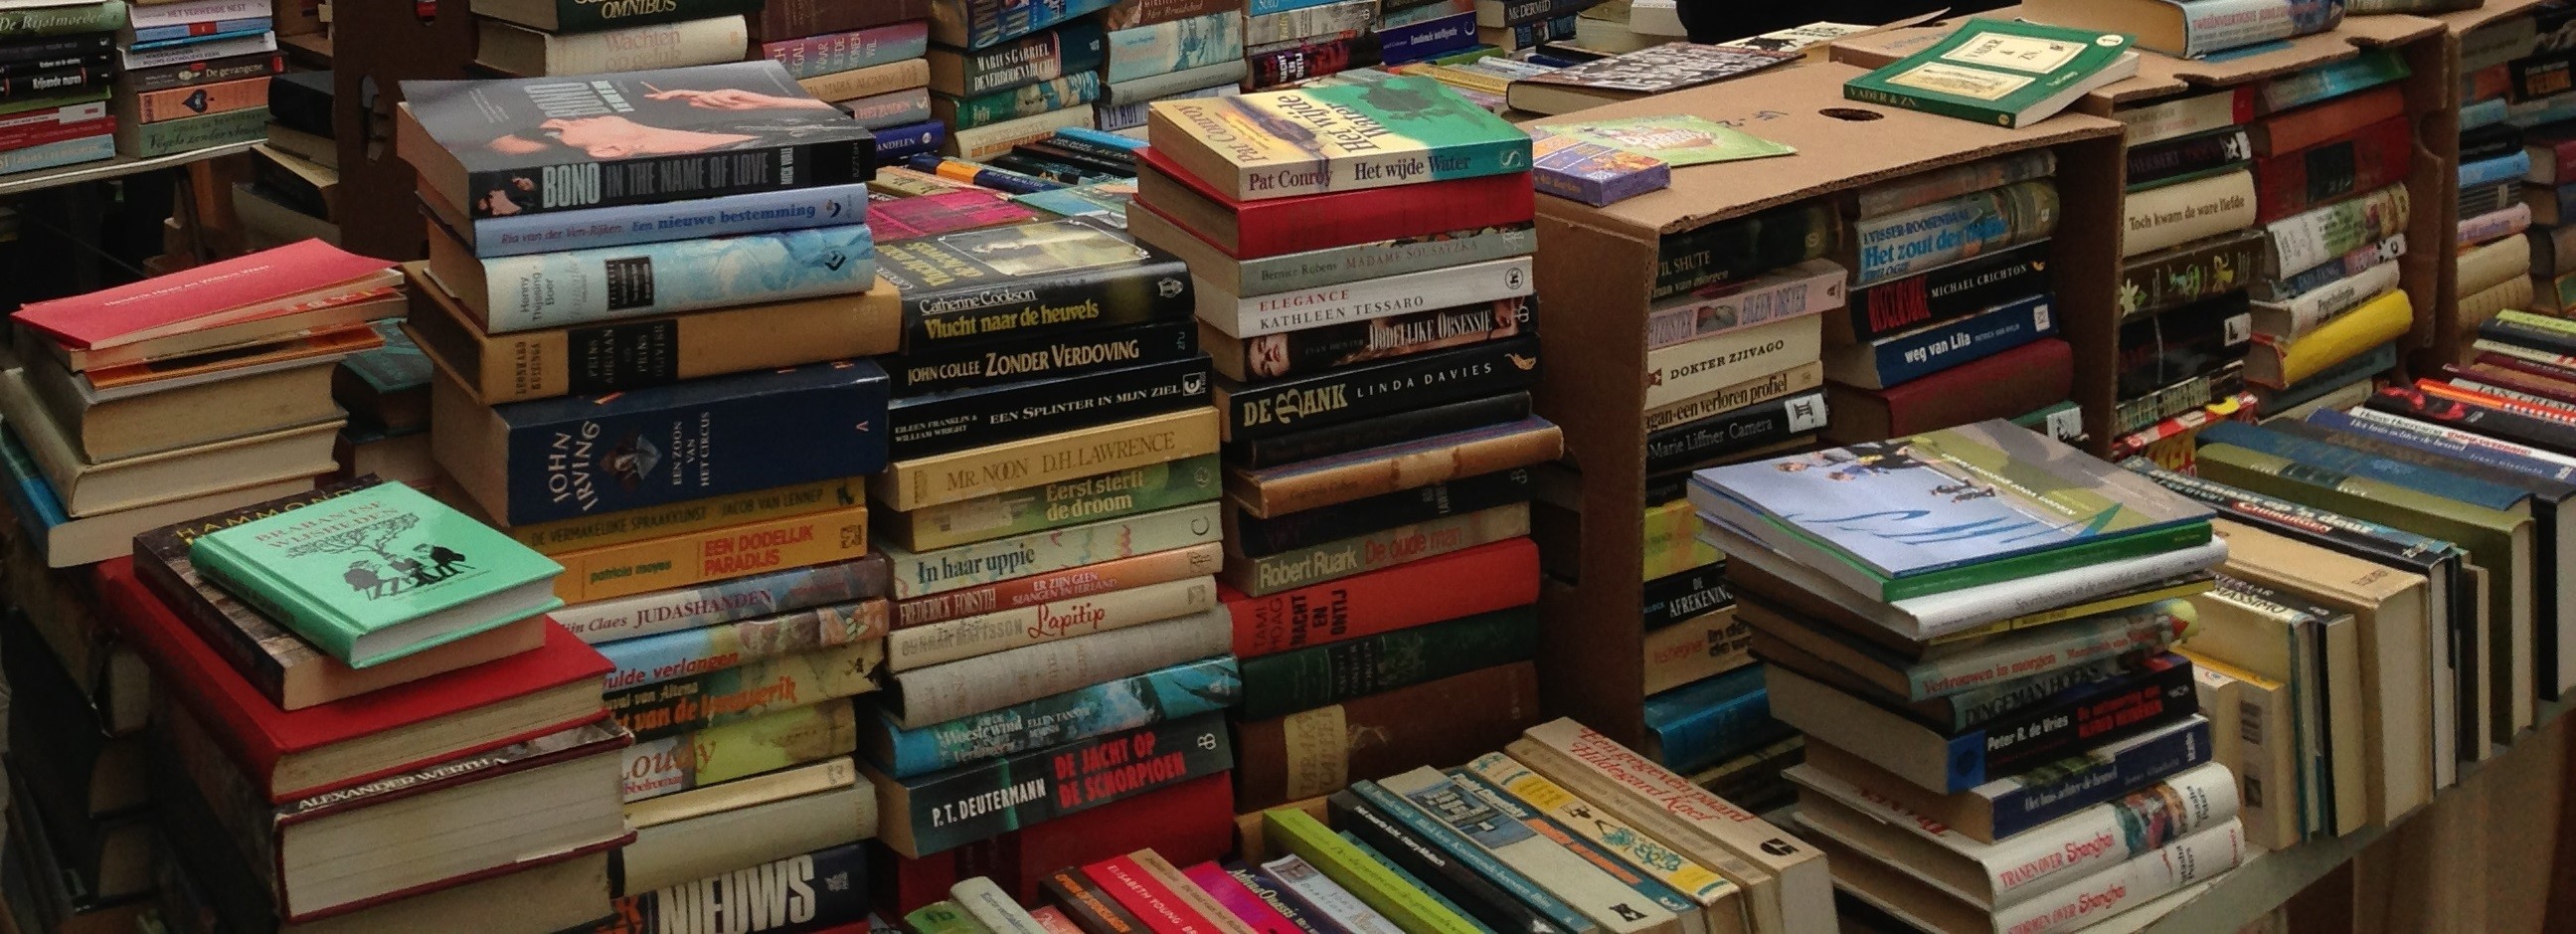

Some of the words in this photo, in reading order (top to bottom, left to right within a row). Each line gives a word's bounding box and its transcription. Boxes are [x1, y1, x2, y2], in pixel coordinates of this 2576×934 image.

[601, 0, 676, 20] OMNIBUS
[542, 162, 600, 209] BONO
[606, 169, 624, 196] IN
[628, 163, 655, 193] THE
[661, 157, 704, 192] NAME
[709, 155, 728, 187] OF
[734, 152, 769, 185] LOVE
[1250, 168, 1274, 191] Pat
[1279, 158, 1333, 189] Conroy
[1355, 162, 1385, 181] Het
[1386, 158, 1424, 181] wijde
[1428, 154, 1470, 173] Water
[658, 213, 715, 229] nieuwe
[720, 204, 815, 228] bestemming
[2130, 215, 2152, 231] Toch
[2153, 210, 2183, 226] kwam
[2185, 205, 2195, 219] de
[2197, 204, 2218, 217] ware
[2219, 196, 2245, 213] liefde
[1864, 246, 1894, 270] Het
[1897, 239, 1933, 263] zout
[920, 292, 979, 315] Catherine
[980, 287, 1037, 305] Cookson
[925, 317, 976, 340] Vlucht
[982, 311, 1018, 333] naar
[1020, 305, 1038, 326] de
[1041, 298, 1100, 323] heuvels
[1260, 288, 1350, 311] ELEGANCE
[1261, 307, 1346, 331] KATHLEEN
[1355, 296, 1424, 320] TESSARO
[908, 367, 938, 385] JOHN
[940, 360, 980, 380] COLLEE
[985, 352, 1048, 377] ZONDER
[1051, 340, 1139, 368] VERDOVING
[1670, 356, 1726, 380] DOKTER
[1729, 340, 1785, 364] ZJIVAGO
[1905, 347, 1927, 364] weg
[1929, 342, 1948, 356] van
[989, 411, 1018, 425] EEN
[1023, 397, 1095, 420] SPLINTER
[1099, 396, 1112, 407] IN
[1151, 385, 1181, 398] ZIEL
[1243, 400, 1272, 427] DE
[1356, 377, 1415, 398] LINDA
[1424, 362, 1493, 385] DAVIES
[1750, 374, 1788, 404] profiel
[1729, 418, 1774, 439] Camera
[548, 432, 572, 504] JOHN
[572, 420, 602, 511] IRVING
[687, 438, 696, 464] VAN
[1078, 431, 1175, 467] LAWRENCE
[1067, 493, 1132, 518] droom
[918, 561, 939, 584] In
[944, 556, 982, 580] haar
[985, 543, 1035, 577] uppie
[1259, 557, 1312, 589] Robert
[1313, 546, 1358, 576] Ruark
[1364, 539, 1385, 564] De
[589, 617, 627, 631] Claes
[633, 590, 772, 630] JUDASHANDEN
[1255, 605, 1269, 650] TAMI
[1270, 597, 1285, 650] HOAG
[1291, 594, 1306, 647] NACHT
[1053, 755, 1076, 781] DE
[1133, 731, 1156, 758] OP
[1987, 728, 2015, 751] Peter
[2029, 723, 2041, 738] de
[959, 778, 1046, 821] DEUTERMANN
